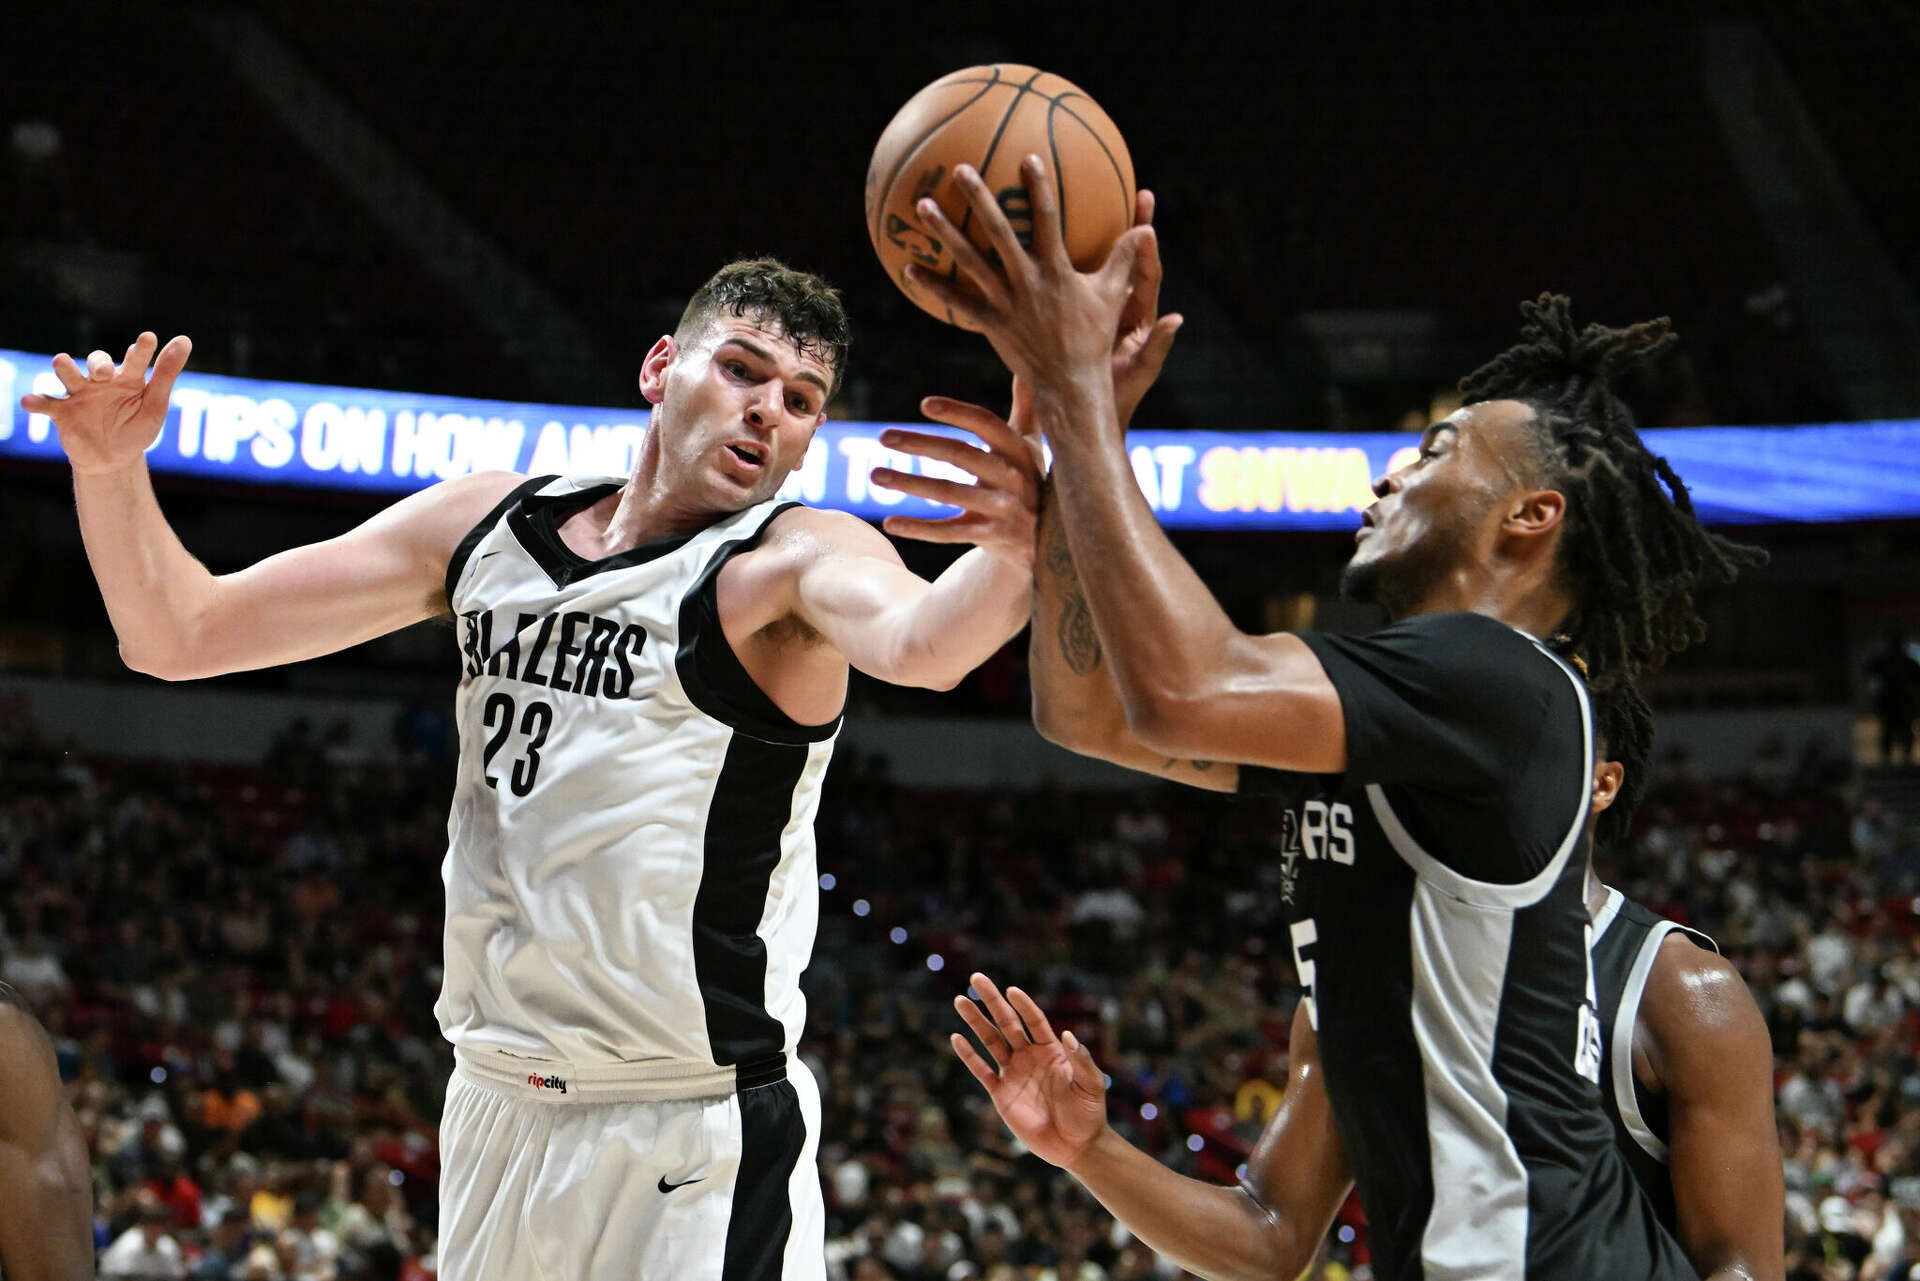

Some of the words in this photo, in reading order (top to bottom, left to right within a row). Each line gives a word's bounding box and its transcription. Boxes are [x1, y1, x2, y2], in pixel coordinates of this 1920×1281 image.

[172, 388, 297, 468] TIPS
[301, 402, 387, 475] ON
[391, 410, 525, 480] HOW
[527, 421, 648, 477] AND
[483, 692, 553, 797] 23
[528, 1072, 567, 1094] ripcity
